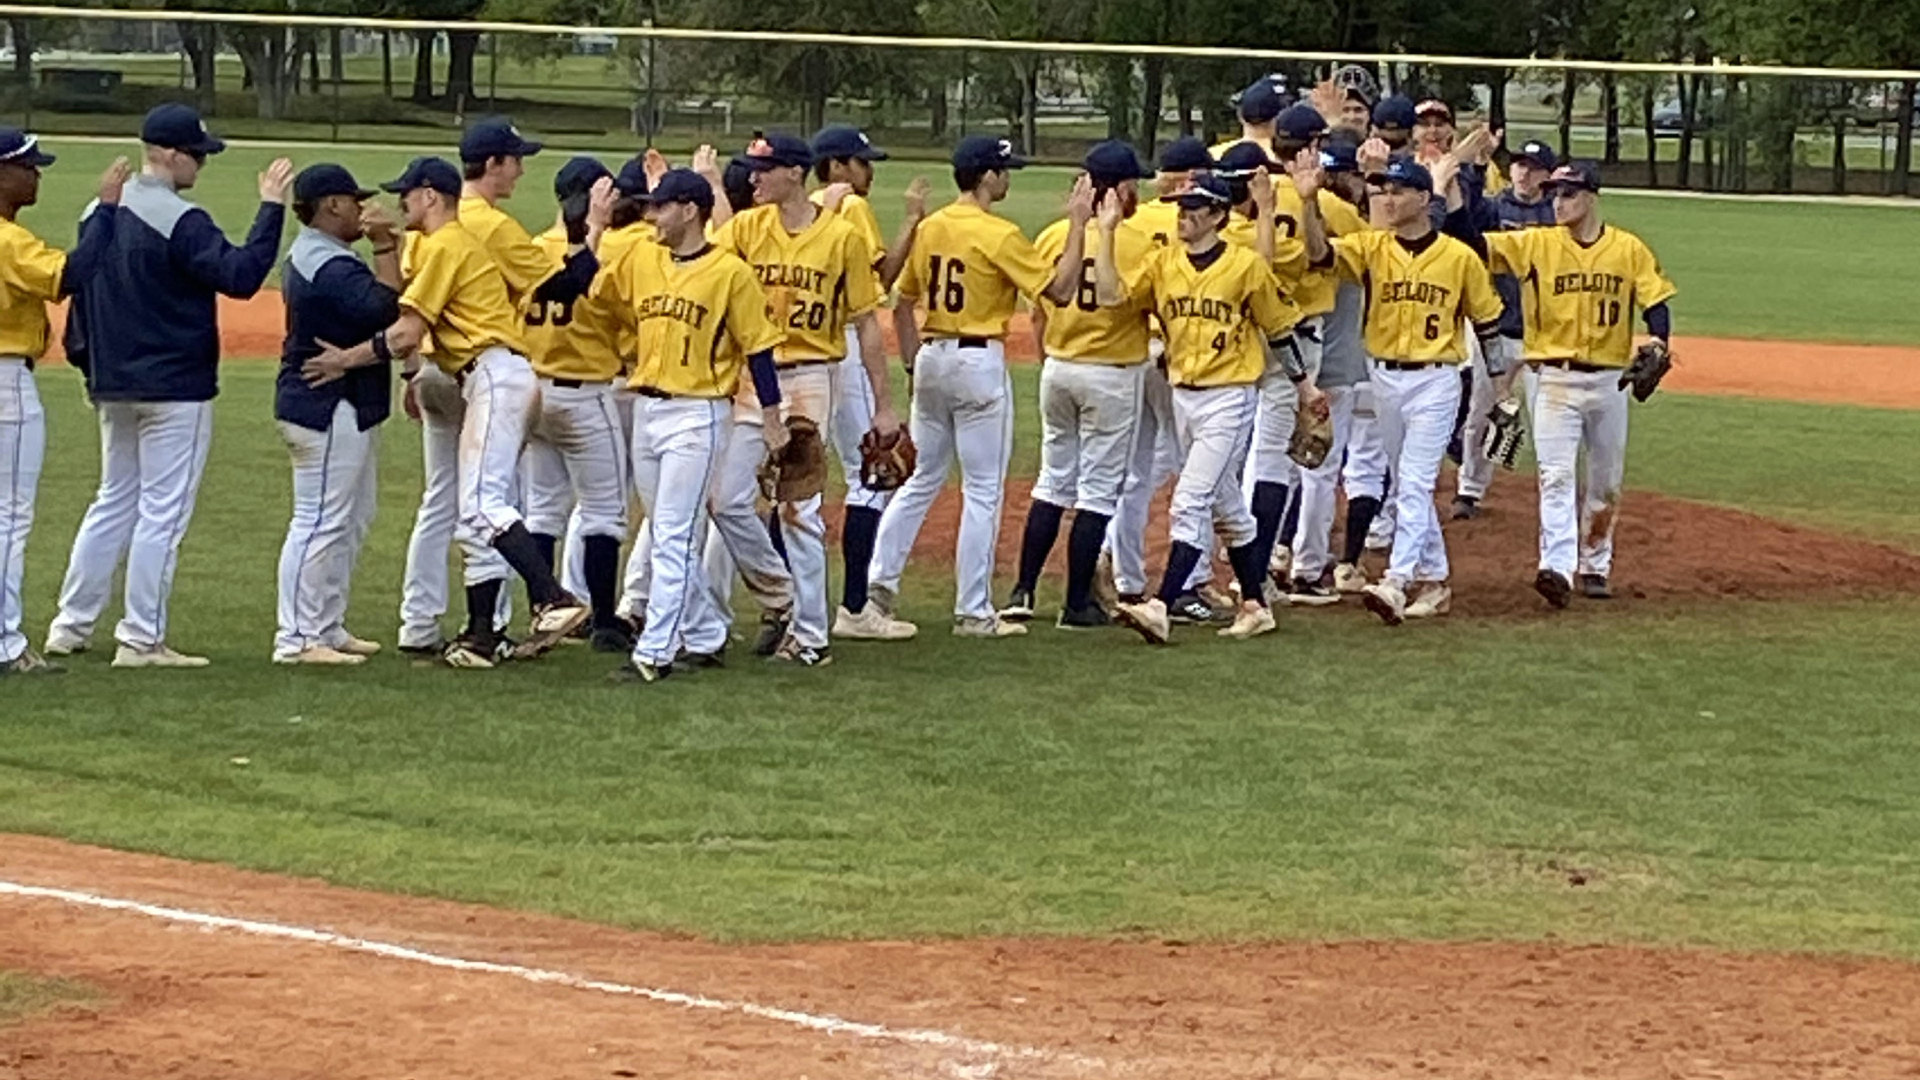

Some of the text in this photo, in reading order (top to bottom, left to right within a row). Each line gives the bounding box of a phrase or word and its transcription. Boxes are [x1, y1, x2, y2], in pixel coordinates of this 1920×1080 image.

[928, 255, 966, 312] 16
[1380, 281, 1451, 308] BELOIT
[1552, 273, 1623, 296] BELOIT
[788, 300, 826, 330] 20
[1425, 313, 1440, 340] 6
[680, 334, 691, 367] 1
[1211, 331, 1226, 354] 4
